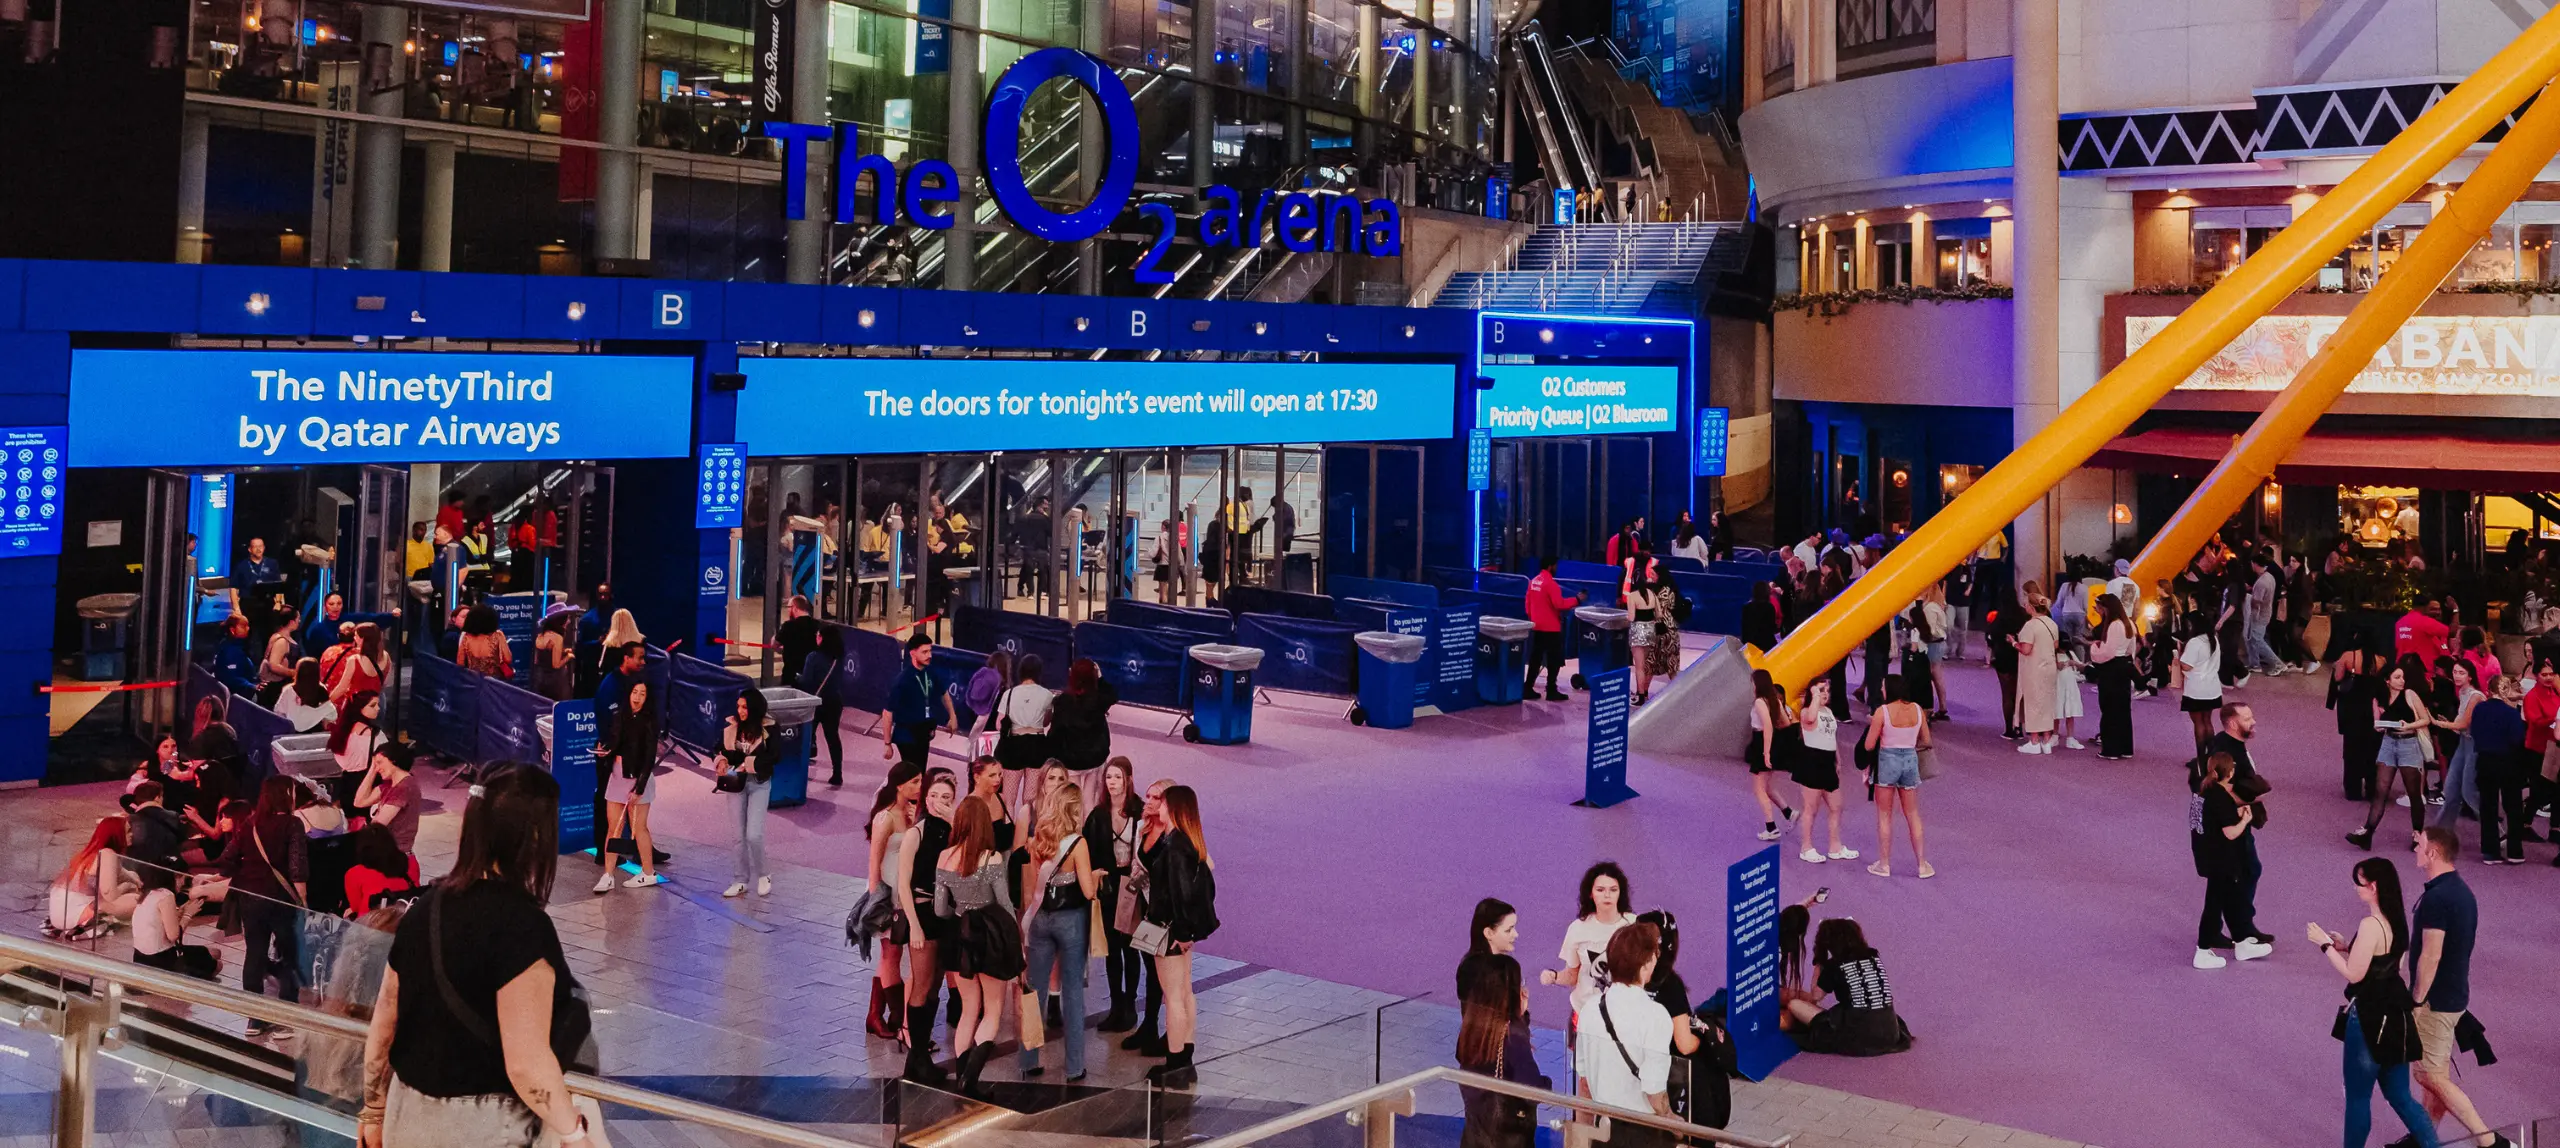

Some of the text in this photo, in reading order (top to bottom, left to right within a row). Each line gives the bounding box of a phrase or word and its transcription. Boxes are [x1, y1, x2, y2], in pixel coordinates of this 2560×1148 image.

[763, 13, 782, 113] Alfa Romeo
[764, 121, 961, 231] The
[1199, 183, 1402, 257] arena
[663, 295, 682, 325] B
[1132, 311, 1146, 337] B
[1494, 321, 1505, 343] B
[251, 369, 553, 409] The NinetyThird
[1541, 376, 1627, 397] O2 Customers
[864, 388, 1378, 421] The doors for tonight's event will open at 17:30
[1489, 405, 1540, 431] Priority
[1541, 405, 1584, 429] Queue
[1592, 404, 1611, 425] O2
[1612, 403, 1668, 424] Blueroom
[239, 415, 560, 456] by Qatar Airways
[506, 605, 520, 613] you
[1398, 624, 1423, 635] large bag?
[1402, 619, 1411, 627] you
[1285, 651, 1296, 661] The
[567, 711, 596, 722] Do yo
[575, 722, 597, 732] larg
